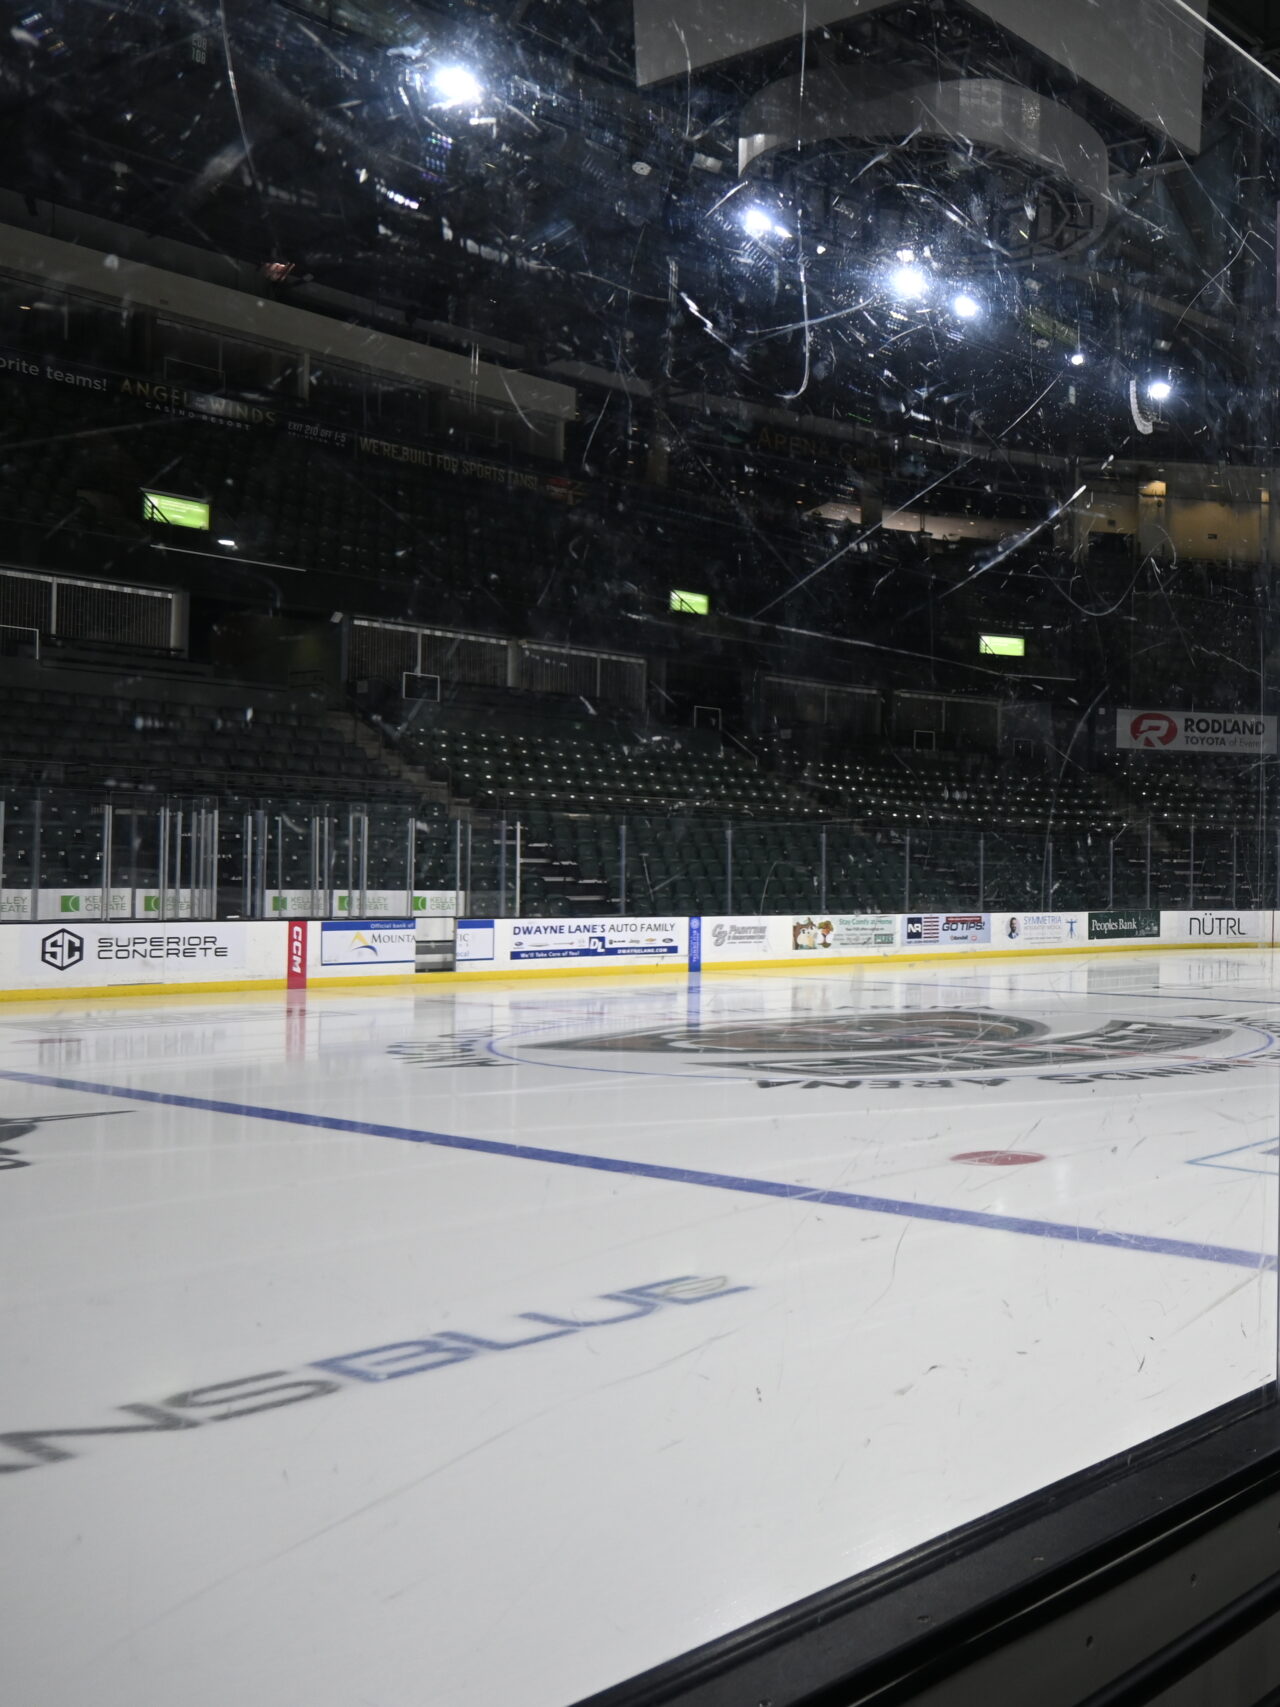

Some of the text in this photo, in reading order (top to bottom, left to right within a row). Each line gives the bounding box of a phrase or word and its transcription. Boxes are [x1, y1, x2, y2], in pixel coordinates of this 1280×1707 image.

[46, 365, 107, 391] teams!
[208, 397, 279, 426] WINDS
[399, 444, 433, 466] BUILT
[436, 452, 458, 473] FOR
[462, 460, 505, 483] SPORTS
[1184, 718, 1265, 735] RODLAND
[1184, 735, 1226, 747] TOYOTA
[85, 895, 125, 903] KEEY
[513, 922, 676, 935] DWAYNE LANE'S AUTO FAMILY
[907, 924, 922, 933] NR
[942, 921, 986, 931] GO TIPS!
[1091, 918, 1137, 934] Peoples Bank
[98, 936, 218, 948] SUPERIOR
[371, 933, 416, 943] MOUNTA
[98, 947, 228, 959] CONCRETE
[292, 926, 302, 973] CCM
[756, 1078, 1011, 1089] ARENA
